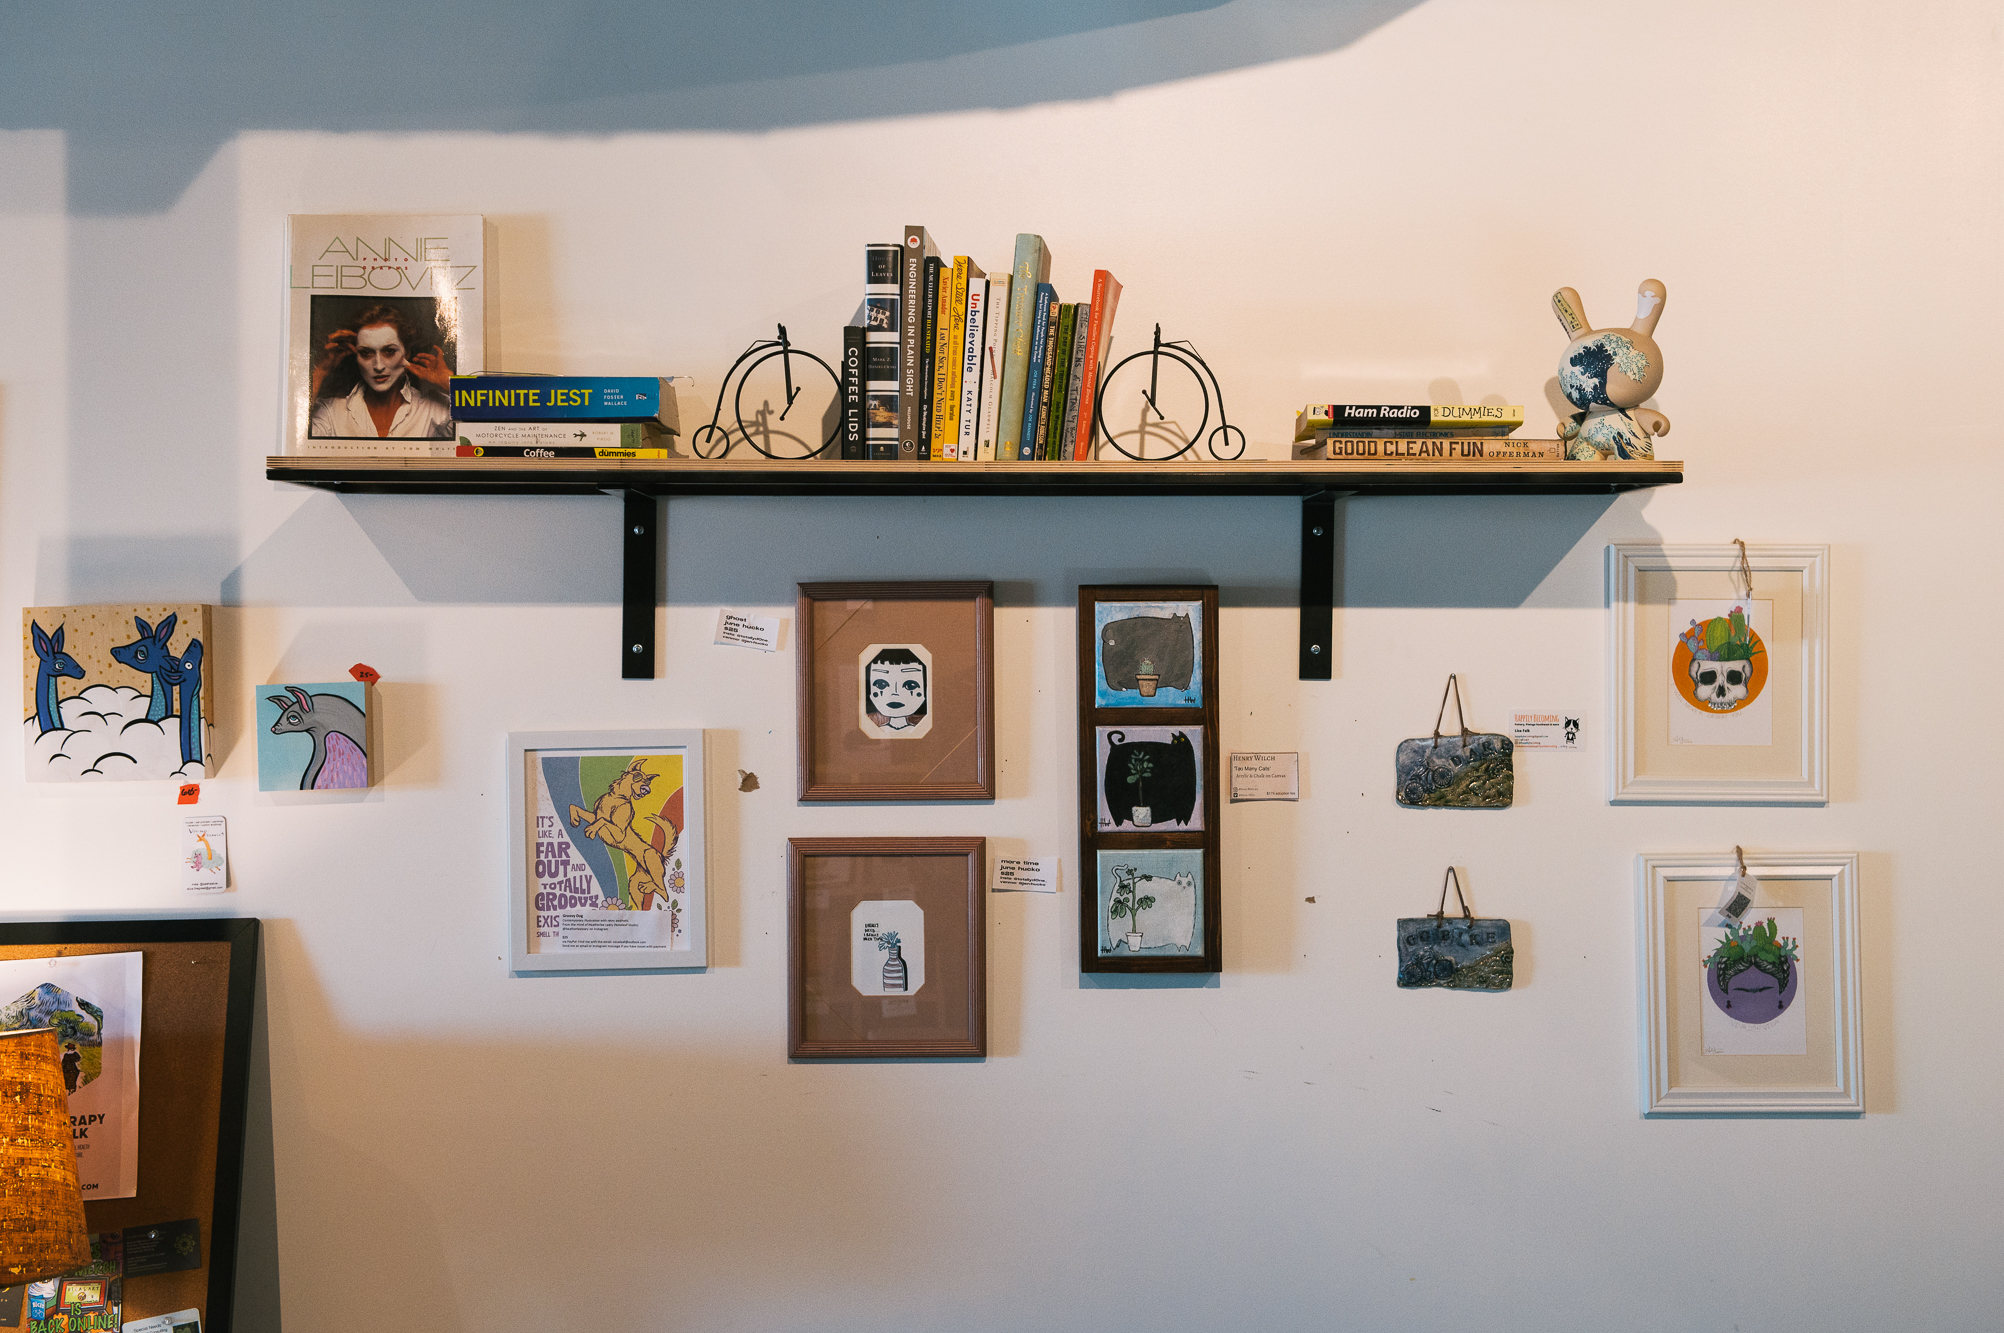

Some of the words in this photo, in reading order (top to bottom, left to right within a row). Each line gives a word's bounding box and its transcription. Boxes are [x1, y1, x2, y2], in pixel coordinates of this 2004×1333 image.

[318, 236, 450, 262] ANNIE
[1018, 262, 1032, 283] The
[908, 258, 916, 323] ENGINEERING
[950, 307, 964, 332] Here
[908, 326, 915, 336] IN
[966, 293, 980, 372] Unbelievable
[907, 339, 915, 366] PLAIN
[1075, 334, 1085, 368] SIRENS
[848, 347, 858, 403] COFFEE
[906, 369, 914, 397] SIGHT
[1057, 370, 1065, 393] TRIFFIDS
[454, 390, 541, 407] INFINITE
[546, 389, 593, 406] JEST
[1344, 406, 1377, 418] Ham
[1380, 406, 1420, 418] Radio
[1441, 406, 1504, 419] DUMMIES
[848, 410, 858, 441] LIDS
[523, 449, 555, 458] Coffee
[598, 450, 636, 458] dummies
[1332, 440, 1378, 457] GOOD
[1383, 441, 1444, 457] CLEAN
[1450, 441, 1484, 457] FUN
[1514, 714, 1532, 722] HAPPILY
[1534, 714, 1559, 722] BECOMING
[536, 816, 554, 828] IT'S
[557, 828, 564, 838] A
[536, 841, 571, 859] FAR
[534, 859, 571, 878] OUT
[571, 863, 586, 872] AND
[541, 875, 593, 895] TOTALLY
[534, 892, 599, 912] GROOVY
[536, 915, 560, 928] EXIS
[70, 1114, 105, 1126] RAPY
[73, 1128, 88, 1139] LK
[71, 1303, 82, 1315] IS
[30, 1318, 64, 1333] BACK
[68, 1314, 118, 1331] ONLINE!
